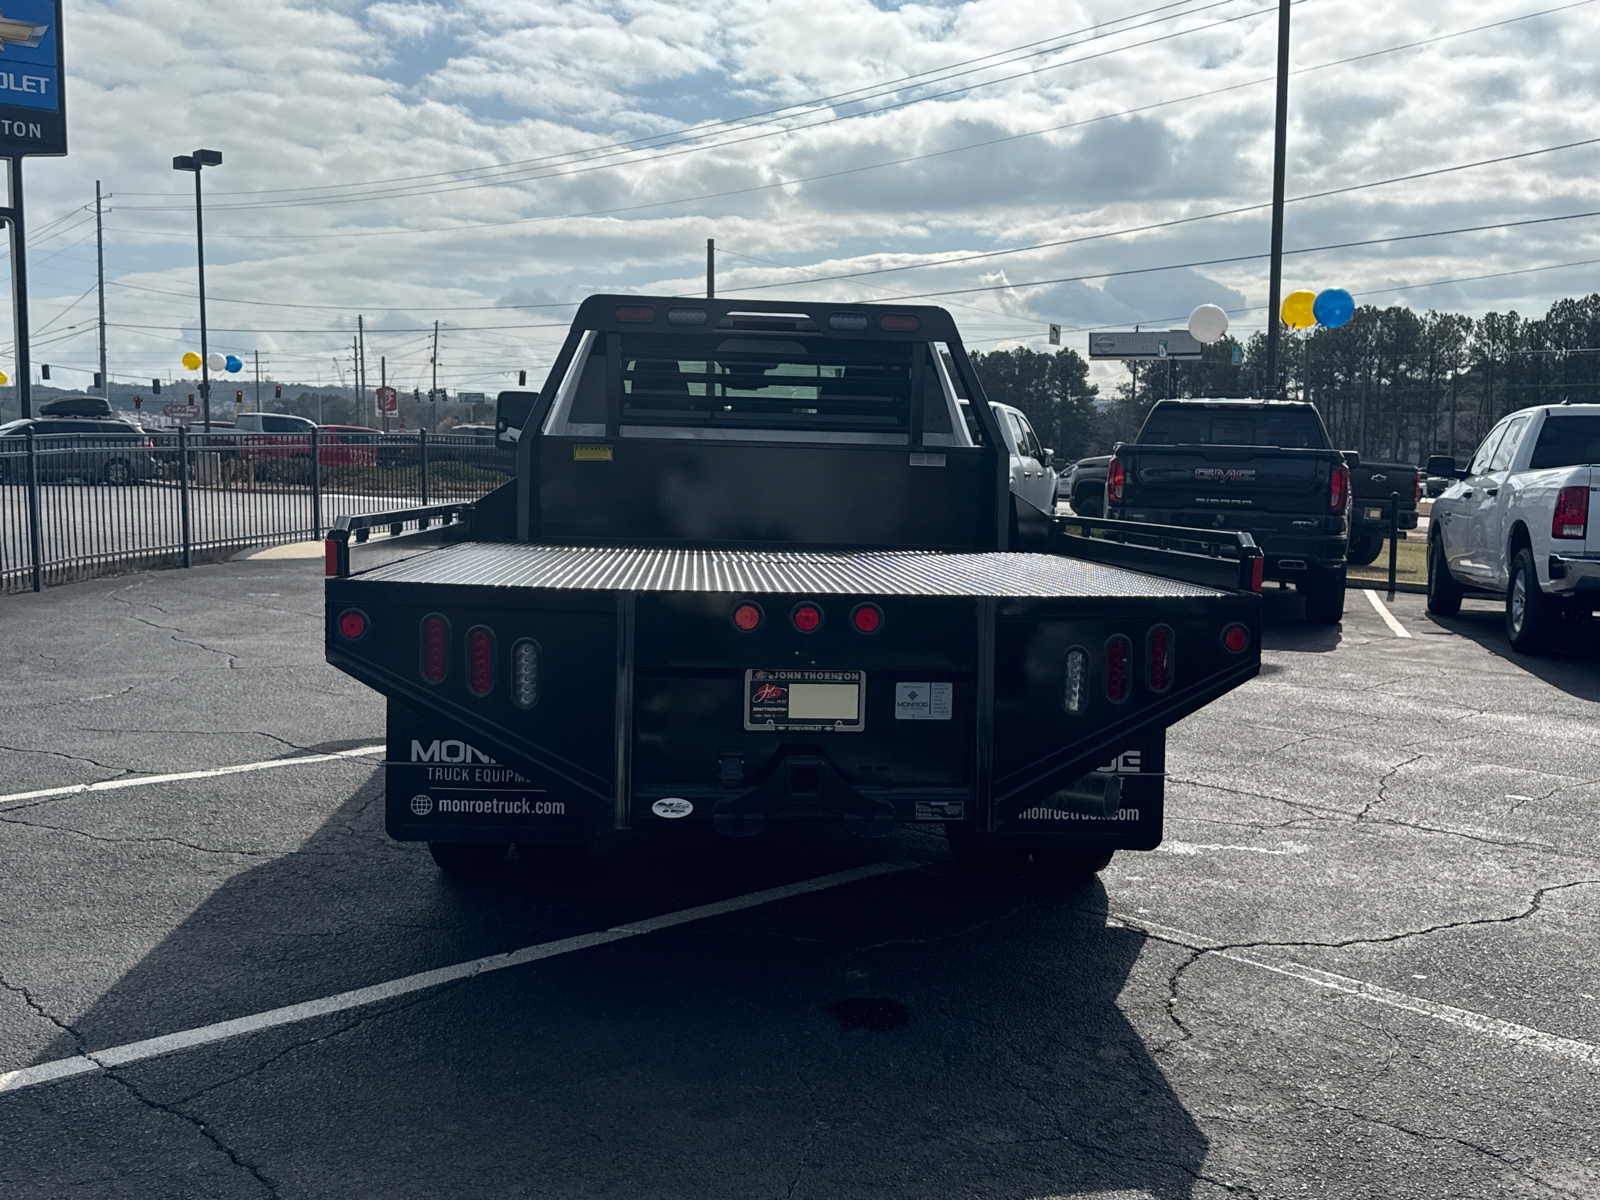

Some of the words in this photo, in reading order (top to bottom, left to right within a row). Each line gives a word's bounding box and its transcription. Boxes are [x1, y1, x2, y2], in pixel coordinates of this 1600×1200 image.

[1, 119, 42, 139] TON
[1194, 467, 1255, 481] GMC
[773, 671, 802, 680] JOHN
[803, 671, 860, 681] THORNTON
[410, 739, 497, 764] MON
[427, 767, 470, 782] TRUCK
[475, 768, 532, 783] EQUIPM
[438, 797, 566, 815] monroetruck.com
